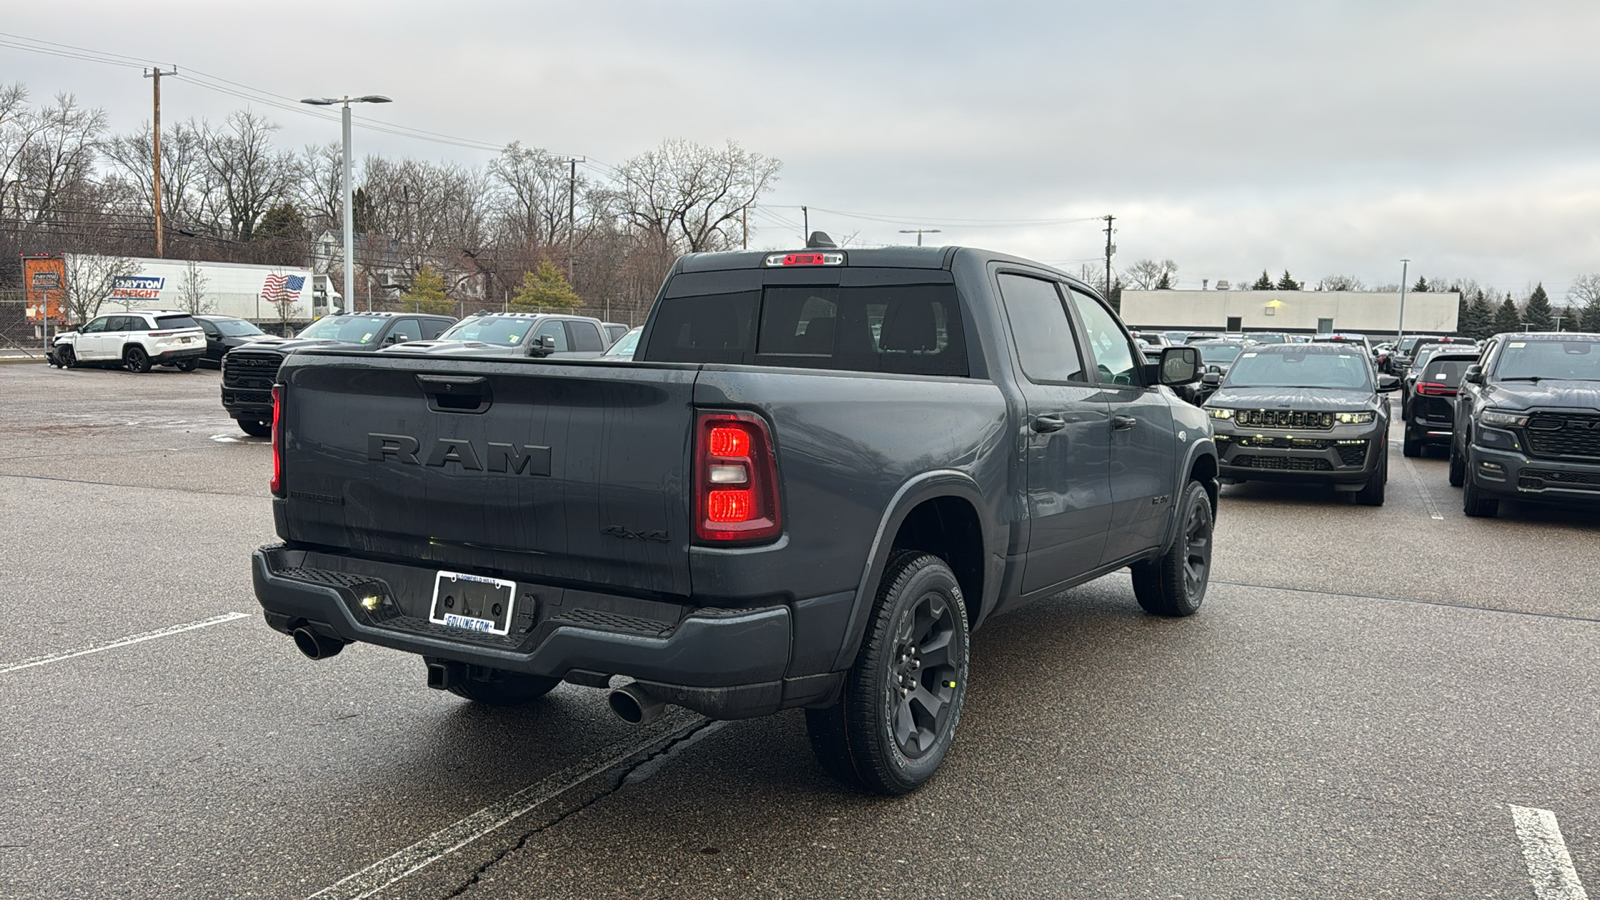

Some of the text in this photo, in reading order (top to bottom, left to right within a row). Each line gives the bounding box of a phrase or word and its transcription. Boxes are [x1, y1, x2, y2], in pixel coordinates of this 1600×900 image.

[115, 279, 161, 288] DAYTON
[113, 289, 160, 298] FREIGHT
[367, 432, 552, 477] RAM
